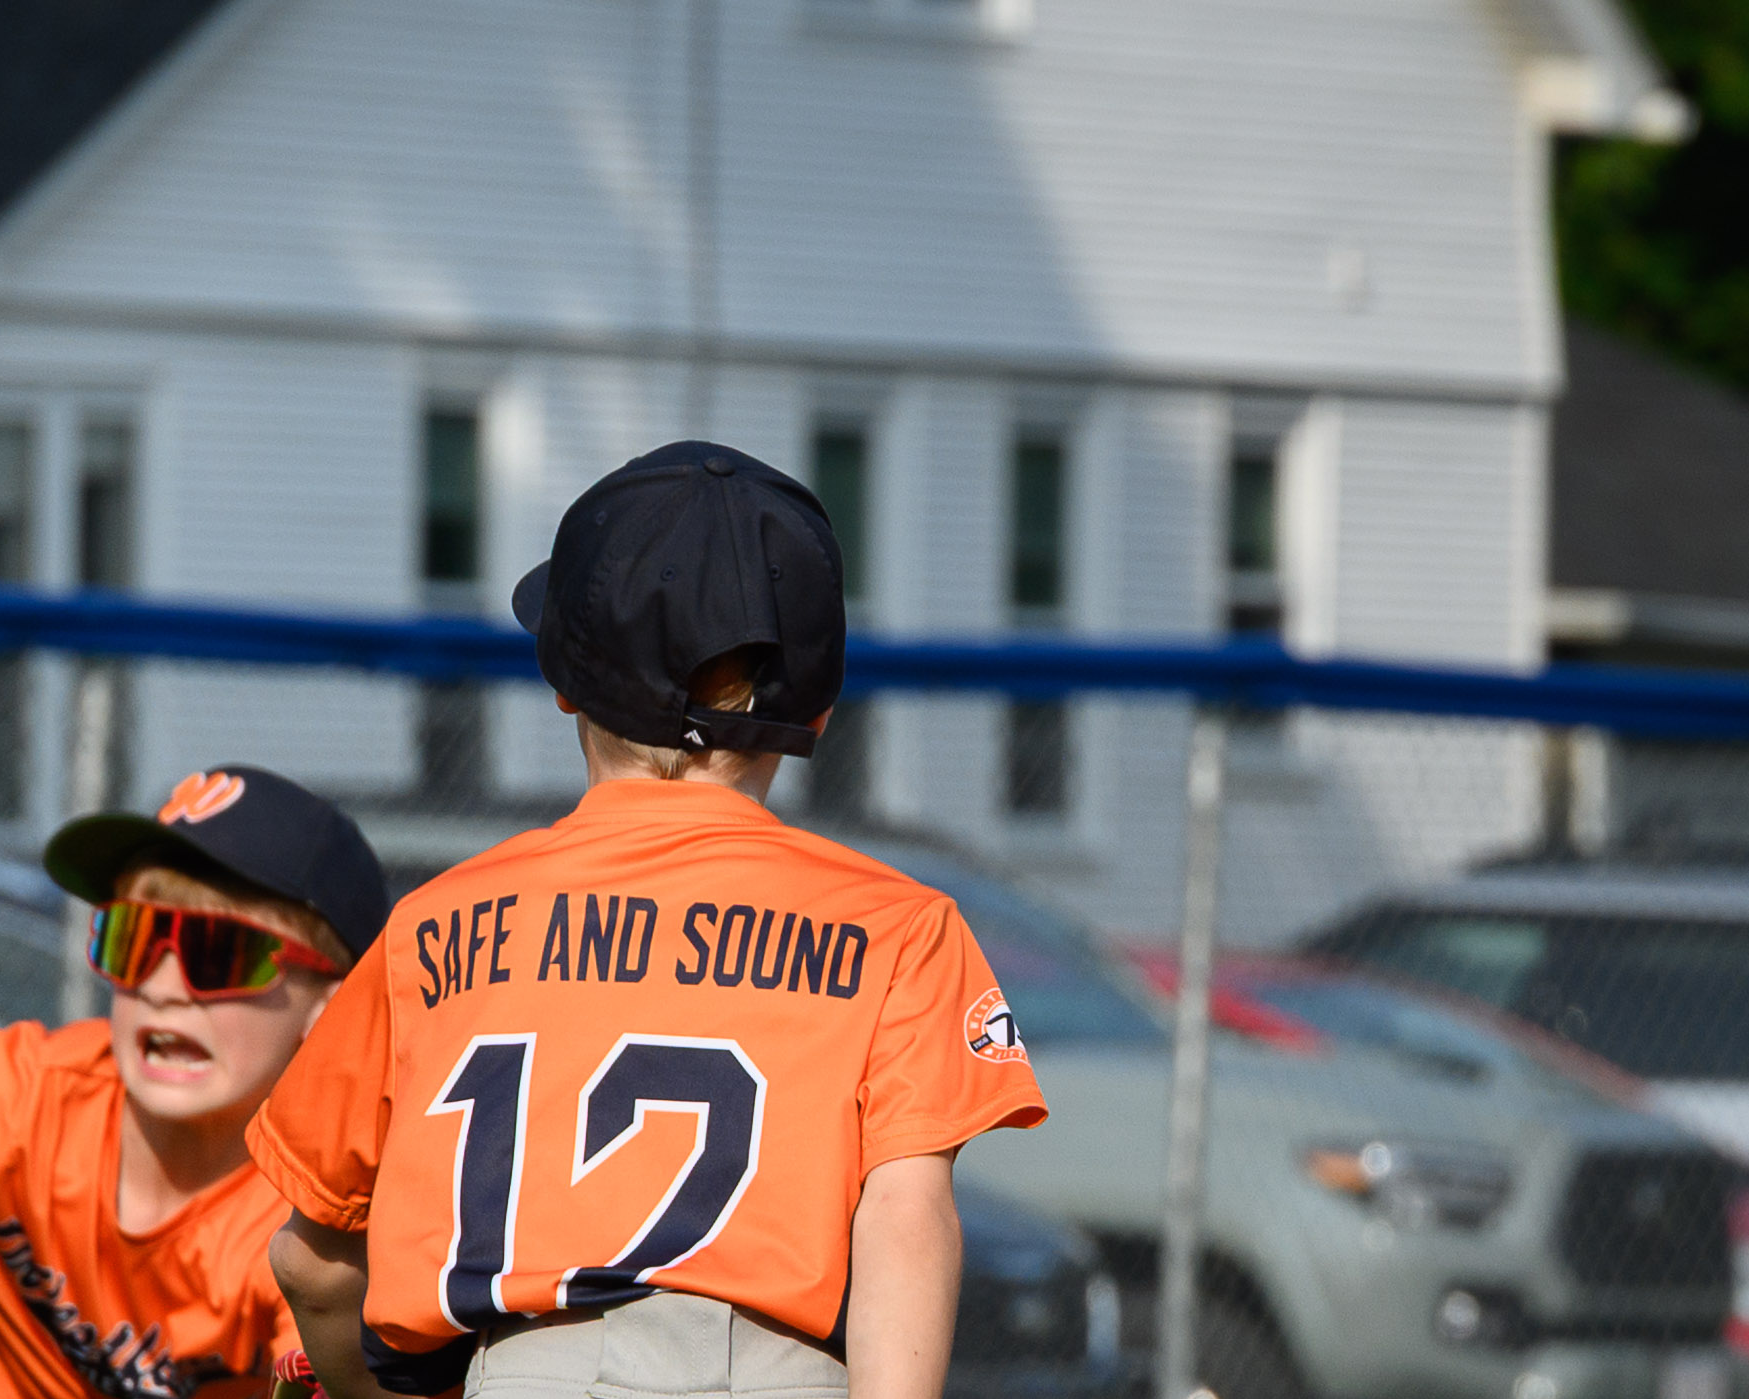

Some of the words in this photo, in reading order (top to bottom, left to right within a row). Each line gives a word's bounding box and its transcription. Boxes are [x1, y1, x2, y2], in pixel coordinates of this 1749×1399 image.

[417, 895, 517, 1008] SAFE
[538, 894, 657, 982] AND
[676, 903, 868, 999] SOUND
[425, 1032, 768, 1332] 12
